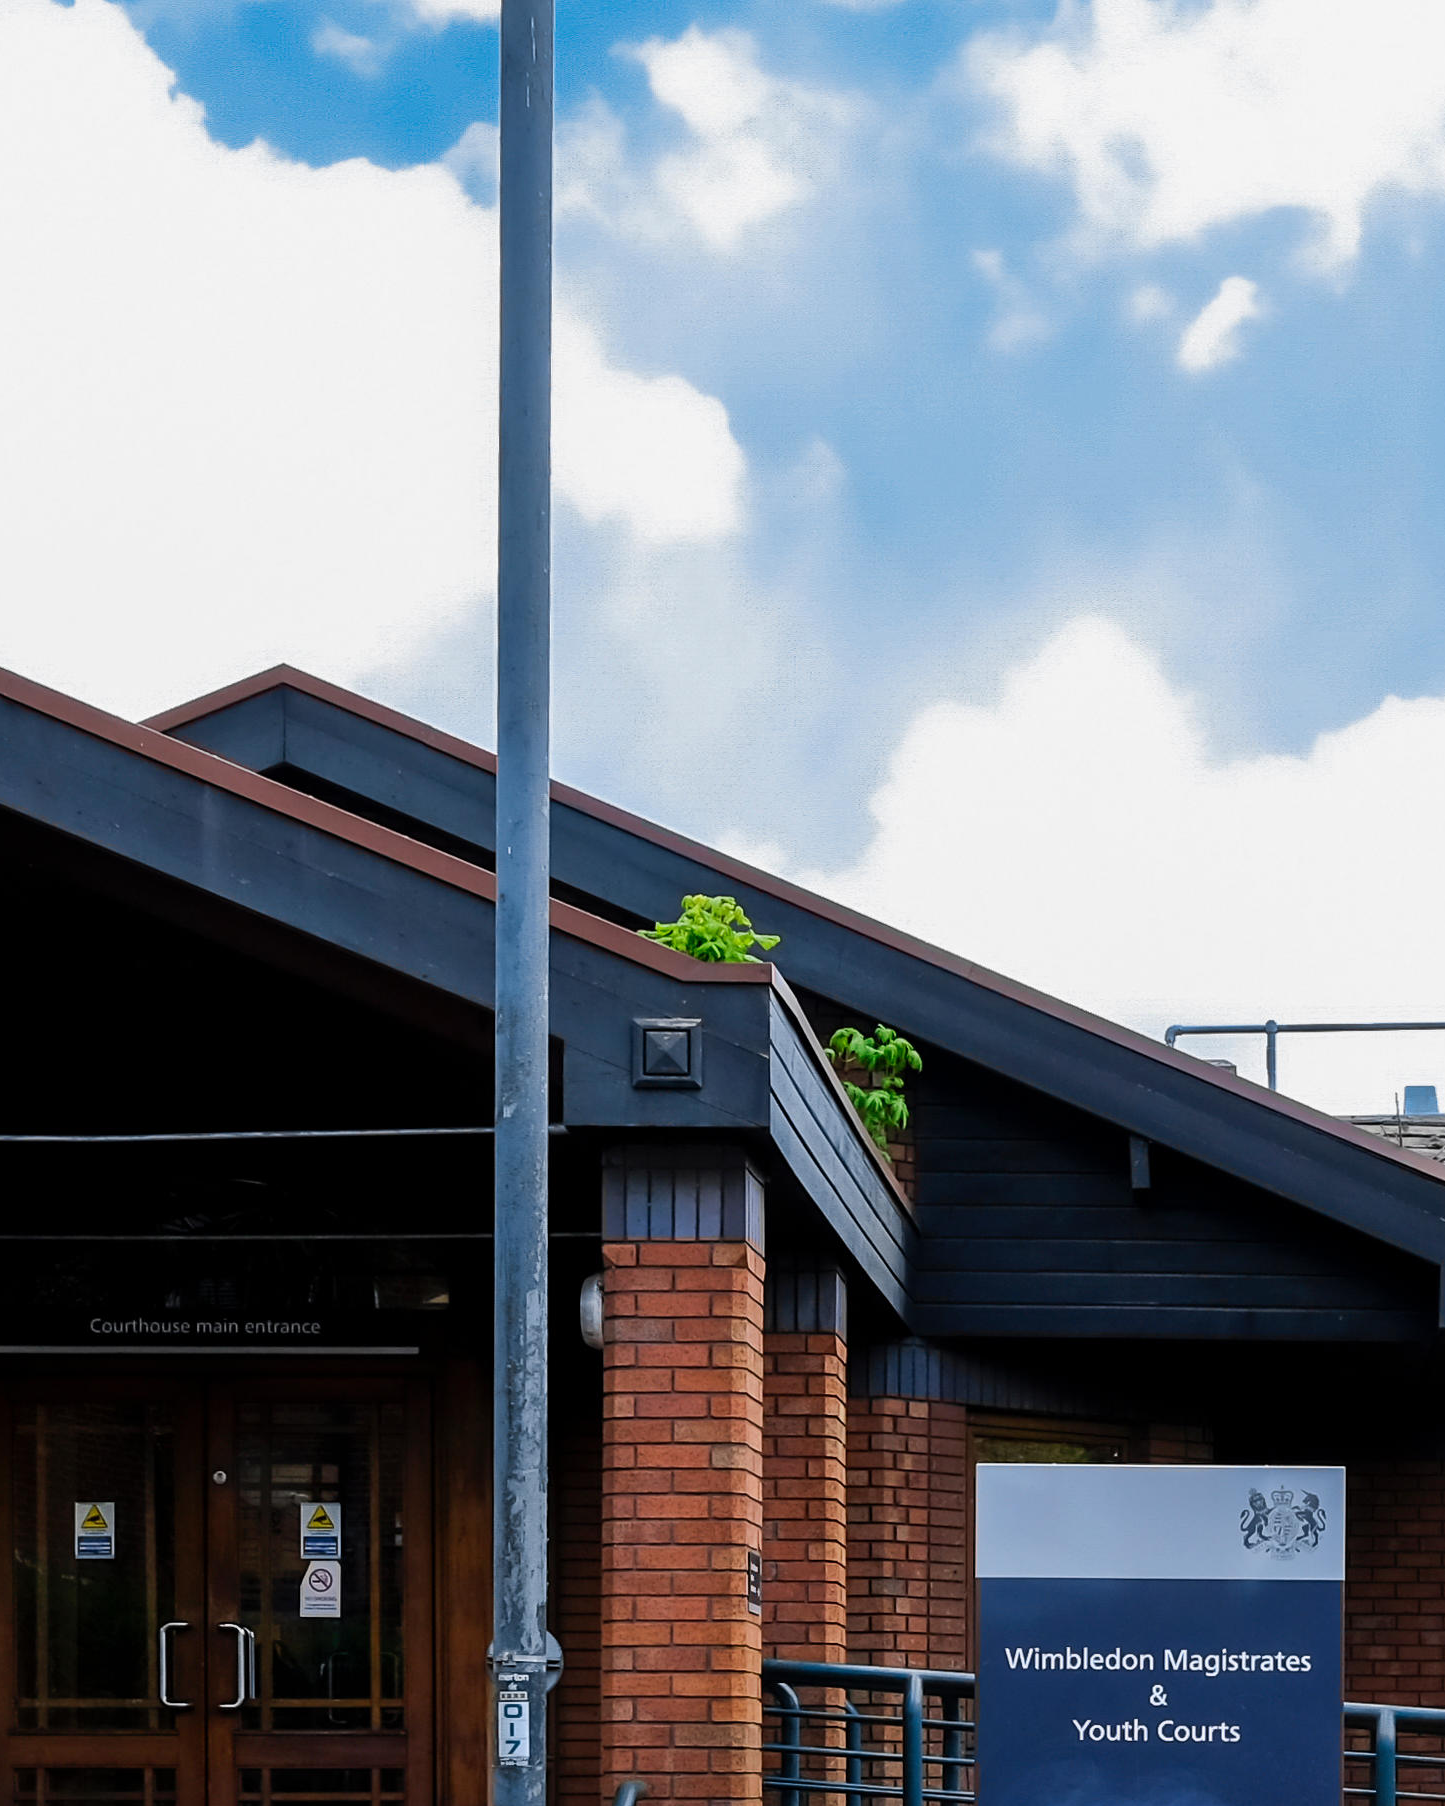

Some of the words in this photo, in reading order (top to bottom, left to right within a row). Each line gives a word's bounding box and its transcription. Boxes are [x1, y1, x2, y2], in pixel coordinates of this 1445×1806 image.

[90, 1318, 190, 1334] Courthouse
[196, 1318, 239, 1334] main
[244, 1320, 321, 1334] entrance
[1005, 1647, 1154, 1671] Wimbledon
[1163, 1648, 1312, 1677] Magistrates
[1149, 1684, 1168, 1706] &
[1072, 1719, 1149, 1742] Youth
[1157, 1720, 1241, 1742] Courts
